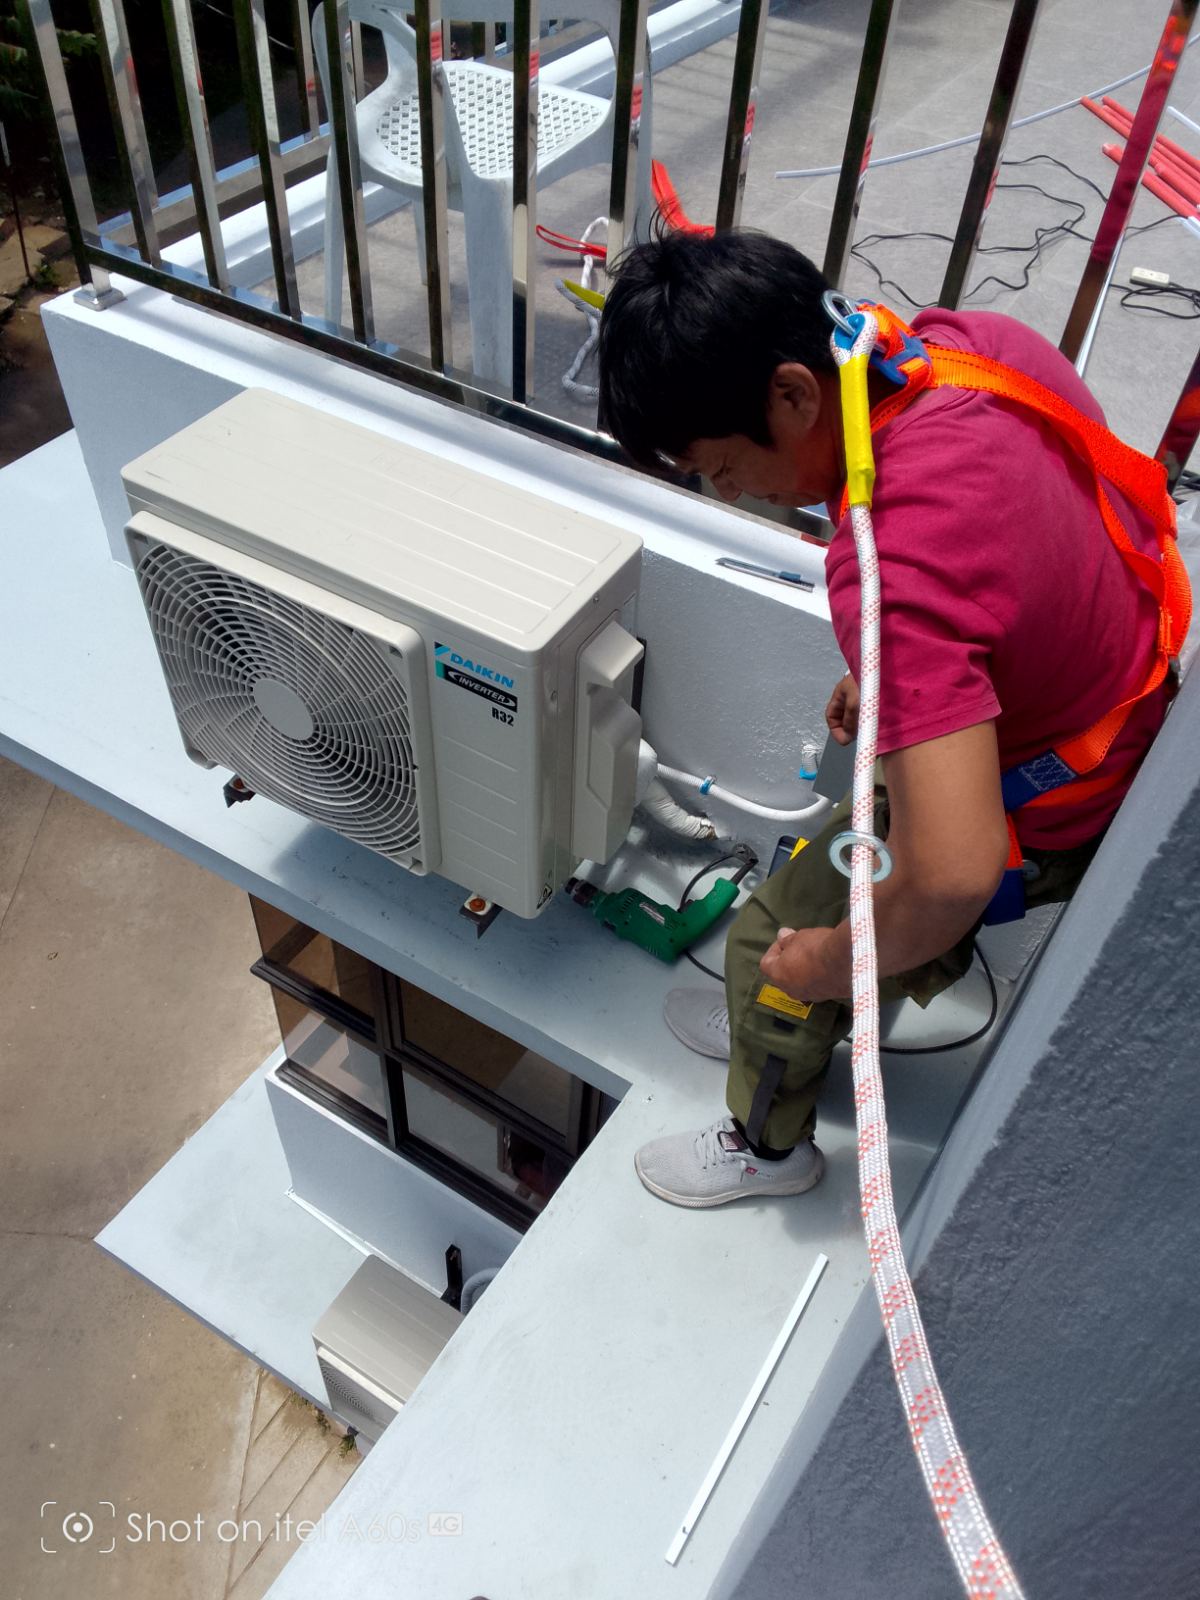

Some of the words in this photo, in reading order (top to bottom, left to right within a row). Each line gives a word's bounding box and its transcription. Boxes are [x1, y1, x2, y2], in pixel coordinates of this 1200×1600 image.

[450, 653, 514, 689] DAIKIN
[459, 676, 507, 704] INVERTER
[491, 707, 514, 727] R32
